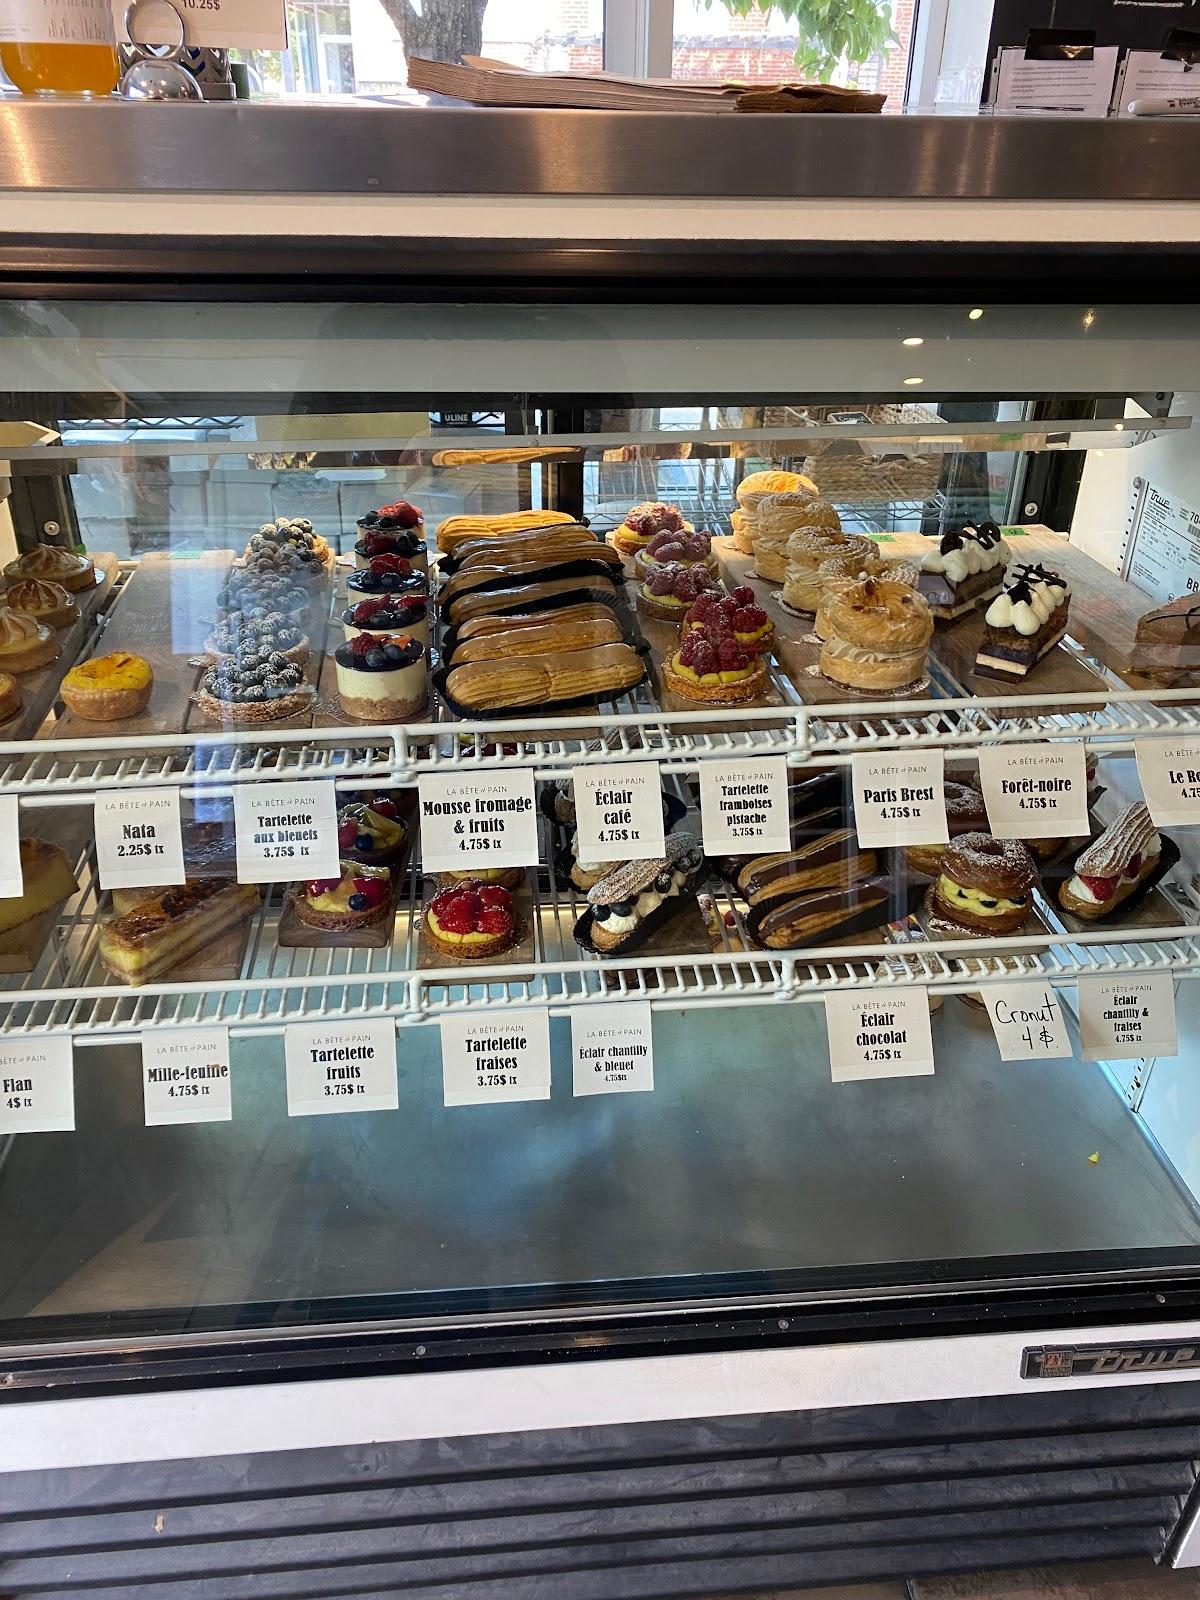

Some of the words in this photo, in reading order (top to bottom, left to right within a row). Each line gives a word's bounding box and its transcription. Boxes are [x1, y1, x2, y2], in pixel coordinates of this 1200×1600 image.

[183, 0, 220, 10] 10.25$
[444, 413, 469, 421] ULINE
[1190, 511, 1200, 524] 70
[1169, 770, 1185, 784] Le
[721, 784, 768, 796] Tartelette
[1001, 778, 1072, 793] Forêt-noire
[595, 789, 632, 805] Éclair
[863, 789, 897, 803] Paris
[901, 786, 934, 801] Brest
[423, 800, 471, 816] Mousse
[475, 796, 532, 813] fromage
[720, 799, 772, 810] framboises
[1019, 797, 1047, 809] 4.75$
[1049, 798, 1057, 807] tx
[604, 809, 631, 824] café
[880, 807, 910, 818] 4.75$
[258, 814, 313, 827] Tartelette
[454, 819, 465, 834] &
[469, 817, 505, 833] fruits
[727, 813, 767, 826] pistache
[122, 824, 156, 840] Nata
[254, 833, 275, 843] aux
[277, 829, 318, 842] bleuets
[598, 829, 628, 841] 4.75$
[732, 827, 754, 836] 3.75$
[117, 843, 152, 856] 2.25$
[459, 838, 490, 850] 4.75$
[264, 846, 295, 858] 3.75$
[1113, 995, 1137, 1006] Éclair
[995, 992, 1057, 1024] Cronut
[1103, 1008, 1140, 1019] chantilly
[1142, 1008, 1149, 1016] &
[861, 1012, 895, 1027] Éclair
[1114, 1022, 1142, 1032] fraises
[856, 1030, 907, 1046] chocolat
[1022, 1026, 1033, 1050] 4
[1040, 1025, 1054, 1048] $
[1115, 1034, 1135, 1042] 4.75$
[465, 1036, 527, 1053] Tartelette
[310, 1046, 375, 1063] Tartelette
[579, 1046, 605, 1059] Éclair
[608, 1045, 647, 1056] chantilly
[864, 1049, 891, 1060] 4.75$
[476, 1056, 517, 1070] fraises
[594, 1062, 602, 1072] &
[605, 1060, 634, 1071] bleuet
[327, 1065, 361, 1080] fruits
[3, 1078, 32, 1093] Flan
[478, 1074, 507, 1086] 3.75$
[168, 1085, 198, 1097] 4.75$
[324, 1084, 354, 1096] 3.75$
[7, 1097, 20, 1108] 4$
